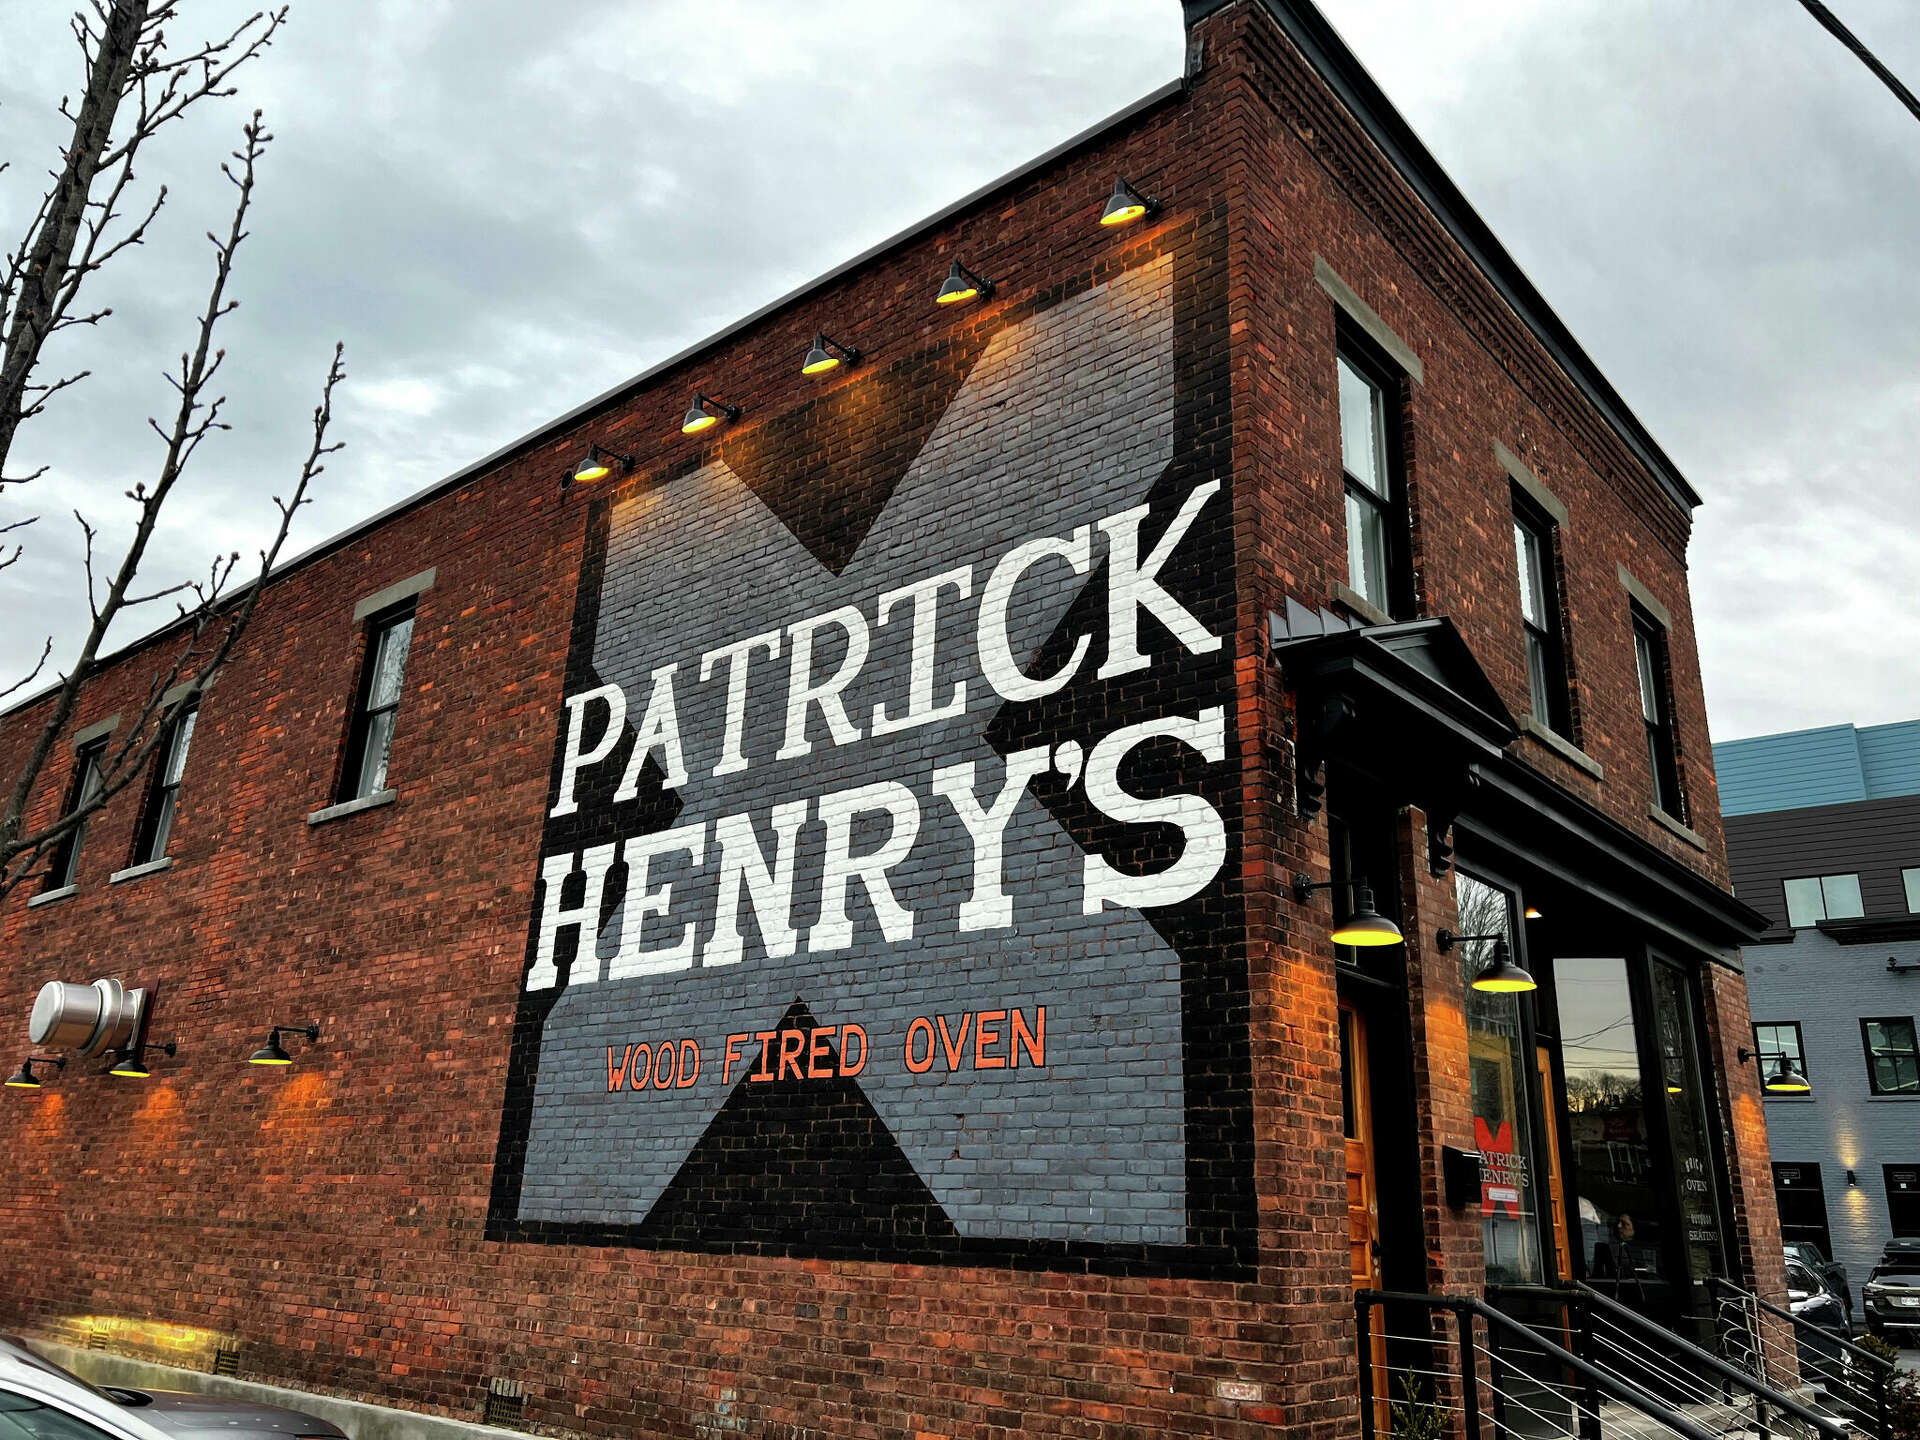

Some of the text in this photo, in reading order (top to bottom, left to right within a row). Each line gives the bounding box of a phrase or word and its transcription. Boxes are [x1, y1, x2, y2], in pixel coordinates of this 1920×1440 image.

[549, 479, 1223, 819] PATRICK
[525, 704, 1227, 992] HENRY'S
[607, 1006, 1047, 1092] WOOD FIRED OVEN
[1478, 1150, 1528, 1170] ATRICK
[1686, 1178, 1708, 1192] OVEN
[1689, 1230, 1719, 1241] SEATING
